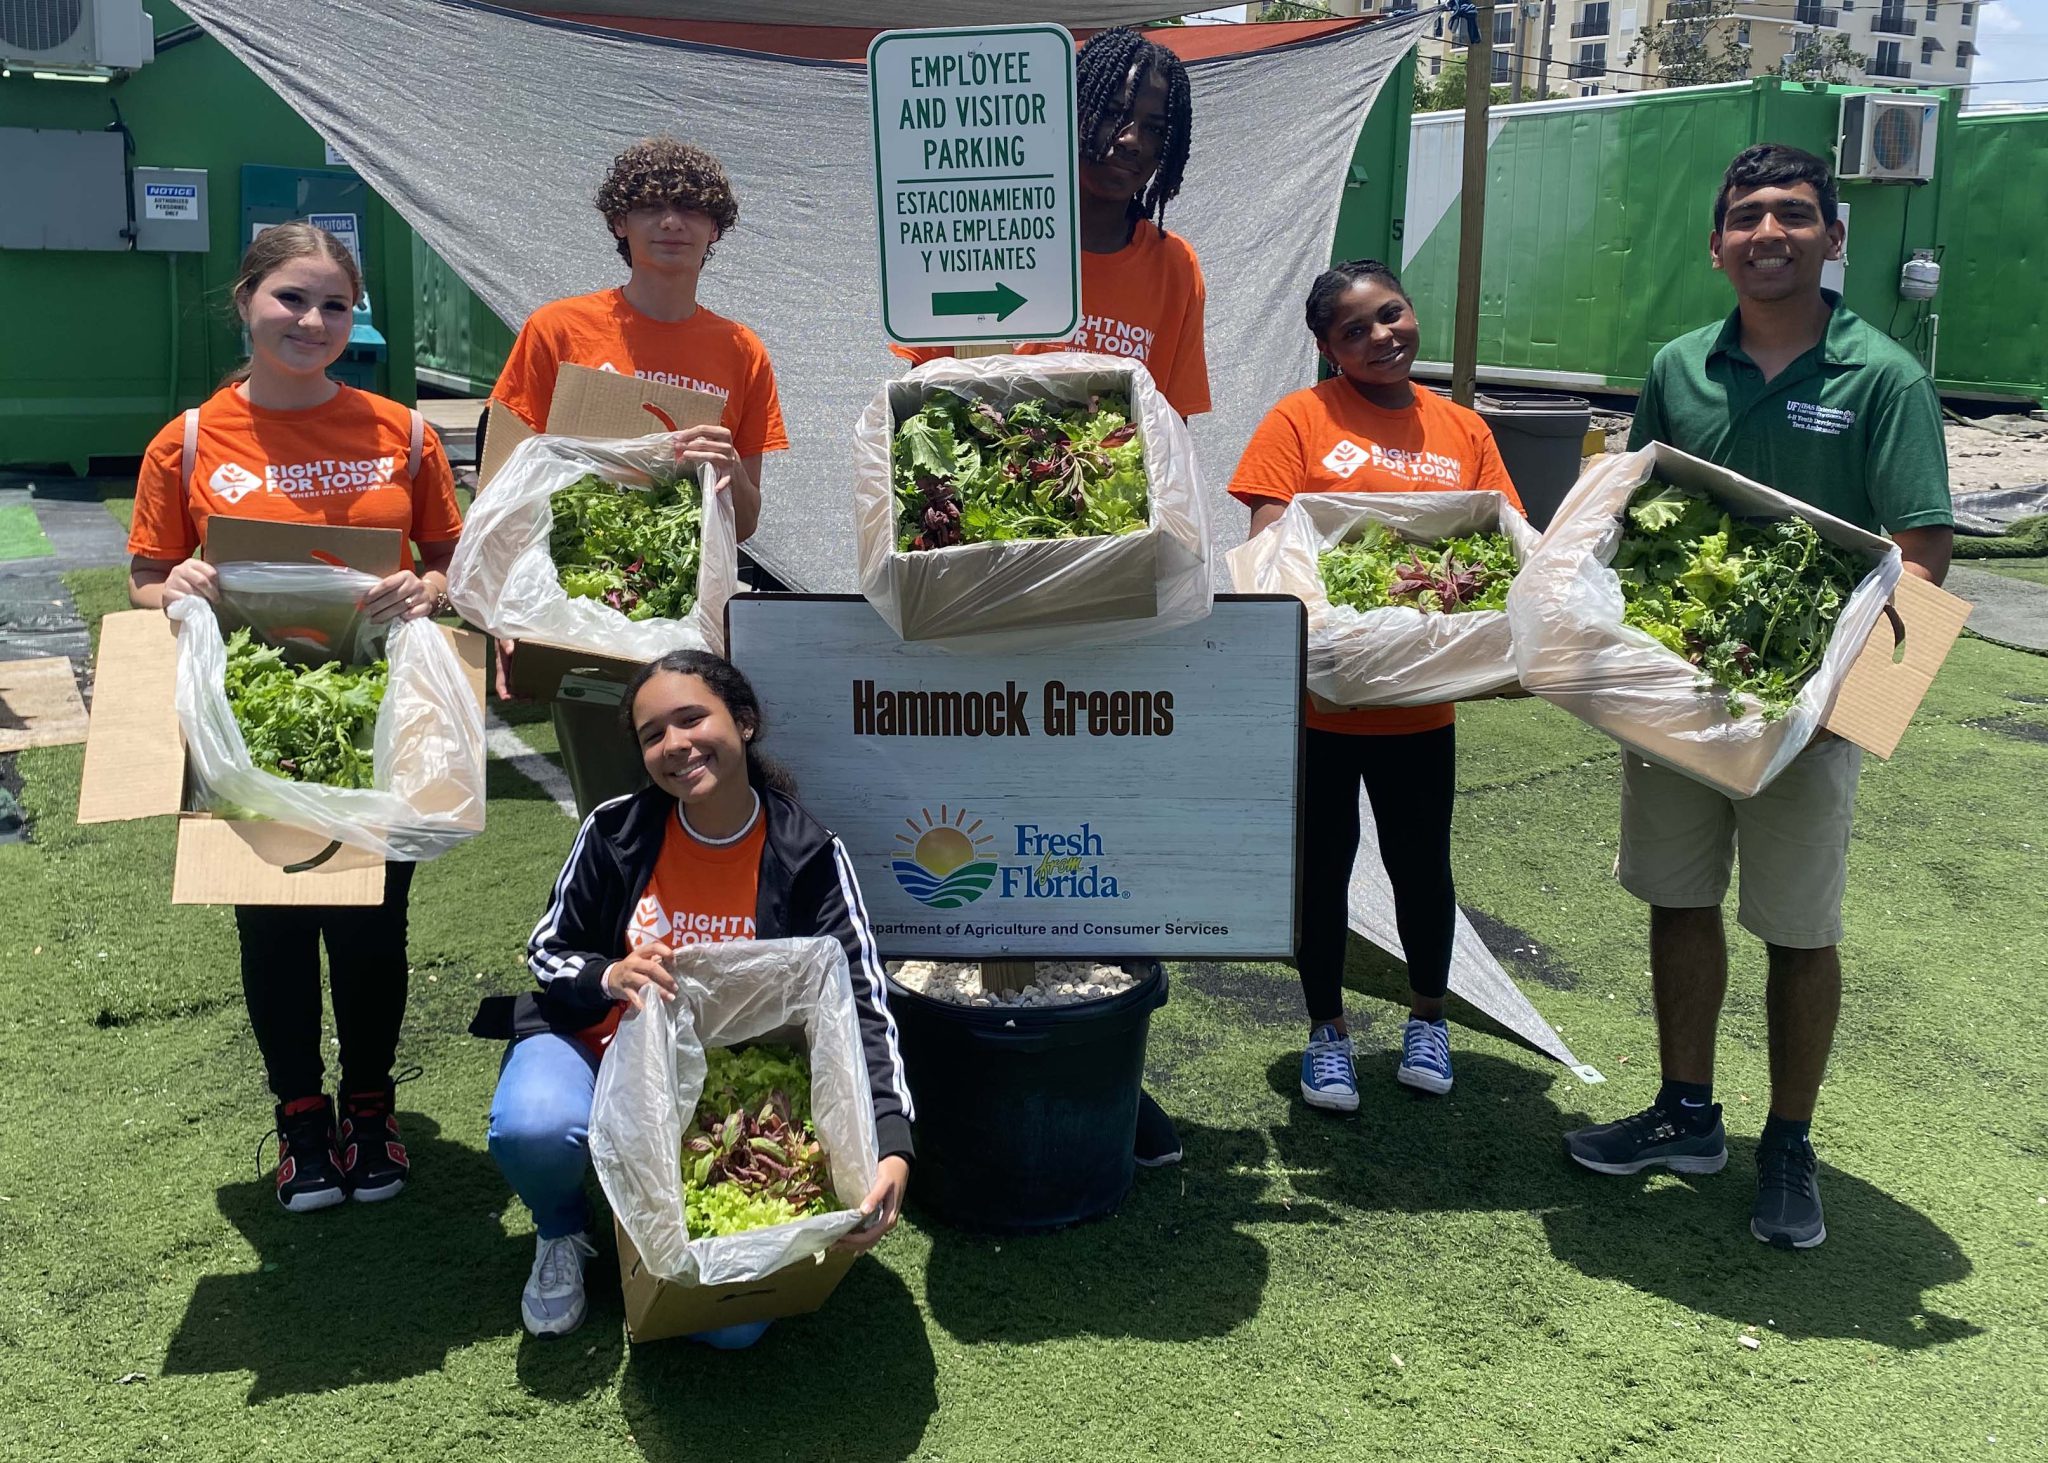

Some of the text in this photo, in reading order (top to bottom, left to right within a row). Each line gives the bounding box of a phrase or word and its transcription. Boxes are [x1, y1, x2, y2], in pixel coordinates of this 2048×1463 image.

[911, 52, 1031, 87] EMPLOYEE
[899, 93, 1046, 129] AND VISITOR
[924, 135, 1025, 170] PARKING
[150, 186, 193, 196] NOTICE
[896, 186, 1056, 215] ESTACIONAMIENTO
[900, 216, 1055, 245] PARA EMPLEADOS
[1392, 218, 1404, 241] 5
[920, 246, 1037, 273] Y VISITANTES
[1786, 400, 1799, 411] UF
[1370, 443, 1424, 463] RIGHT
[265, 456, 394, 480] RIGHT NOW
[265, 468, 394, 493] FOR TODAY
[1372, 455, 1461, 484] FOR TODAY
[290, 490, 320, 499] WHERE
[852, 680, 1174, 737] Hammock Greens
[1013, 822, 1105, 856] Fresh
[1034, 850, 1084, 886] from
[672, 911, 742, 934] RIGHT
[868, 922, 1229, 938] epartment of Agriculture and Consumer Services
